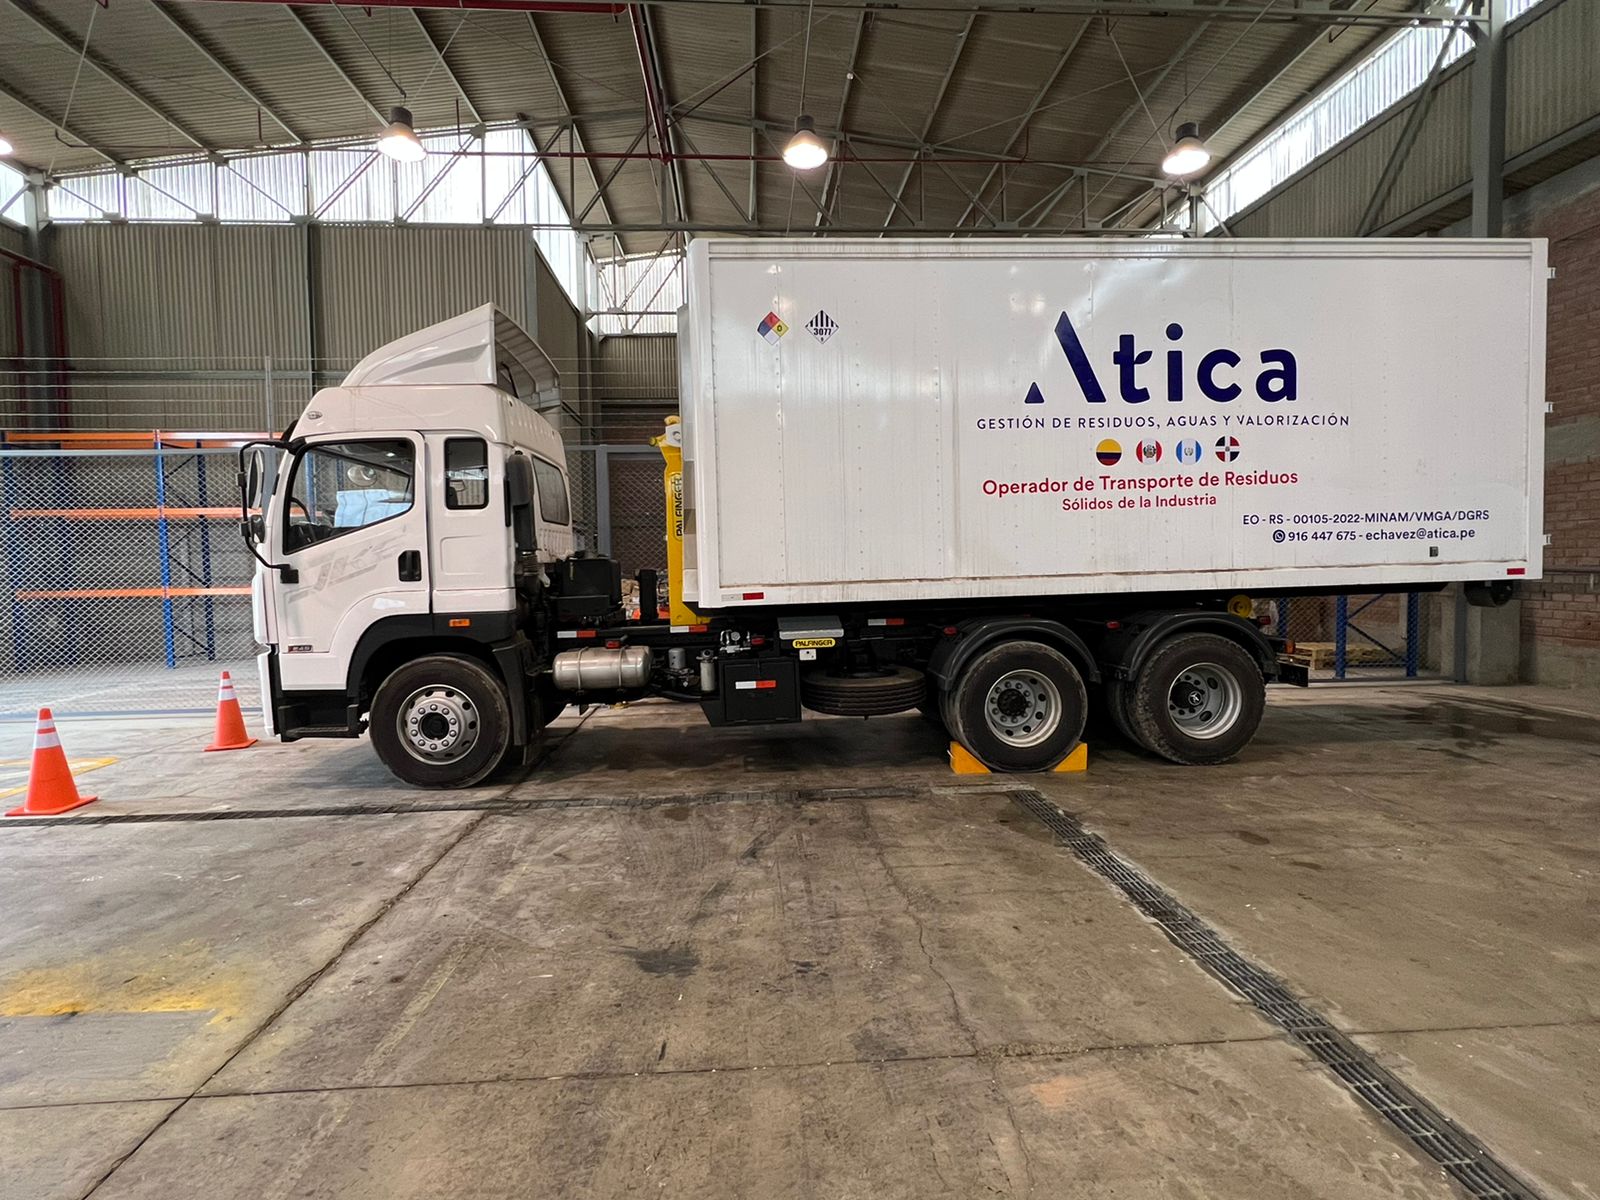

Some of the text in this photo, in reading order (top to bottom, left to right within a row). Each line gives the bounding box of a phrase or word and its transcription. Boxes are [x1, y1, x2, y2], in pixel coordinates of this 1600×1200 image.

[813, 327, 831, 336] 3077
[1024, 310, 1298, 405] Atica
[976, 411, 1350, 430] GESTIÓN DE RESIDUOS, AGUAS Y VALORIZACIÓN
[982, 469, 1298, 498] Operador de Transporte de Residuos
[1062, 493, 1217, 512] Sólidos de la Industria
[1242, 514, 1260, 525] EO
[1269, 514, 1284, 525] RS
[1293, 509, 1490, 525] 00105-2022-MINAM/VMGA/DGRS
[1288, 531, 1309, 542] 916
[1311, 531, 1334, 541] 447
[1336, 530, 1357, 541] 675
[1365, 527, 1476, 542] echavez@atica.pe
[794, 639, 833, 647] PALFINGER
